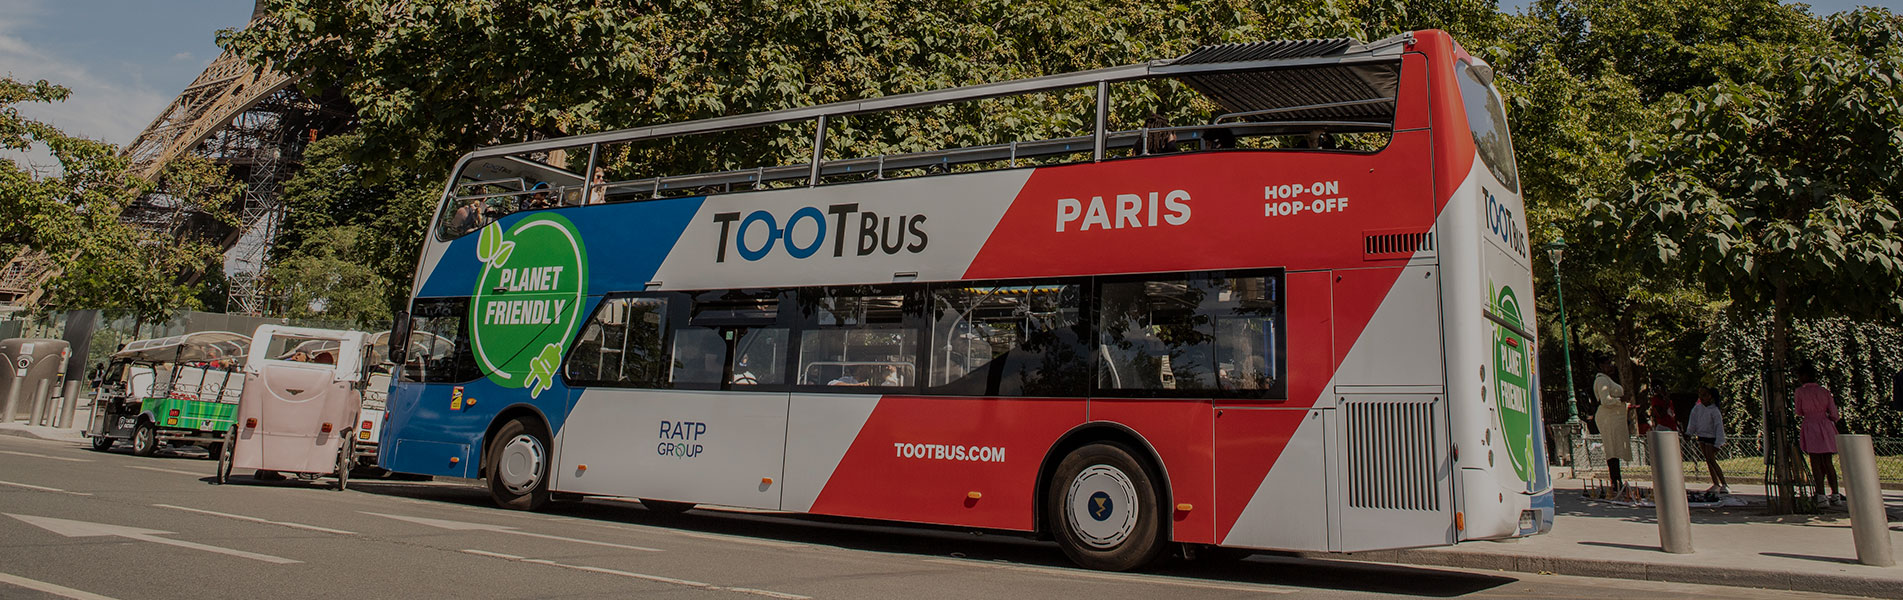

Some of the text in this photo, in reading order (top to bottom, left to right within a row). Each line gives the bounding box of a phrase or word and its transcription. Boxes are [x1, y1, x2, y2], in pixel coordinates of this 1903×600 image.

[1264, 181, 1339, 199] HOP-ON
[1056, 190, 1192, 232] PARIS
[1264, 197, 1349, 217] HOP-OFF
[499, 266, 564, 292] PLANET
[484, 299, 566, 325] FRIENDLY
[1501, 344, 1523, 378] PLANET
[1501, 380, 1528, 415] FRIENDLY
[659, 420, 707, 441] RATP
[657, 442, 704, 459] GROUP
[894, 442, 1006, 462] TOOTBUS.COM
